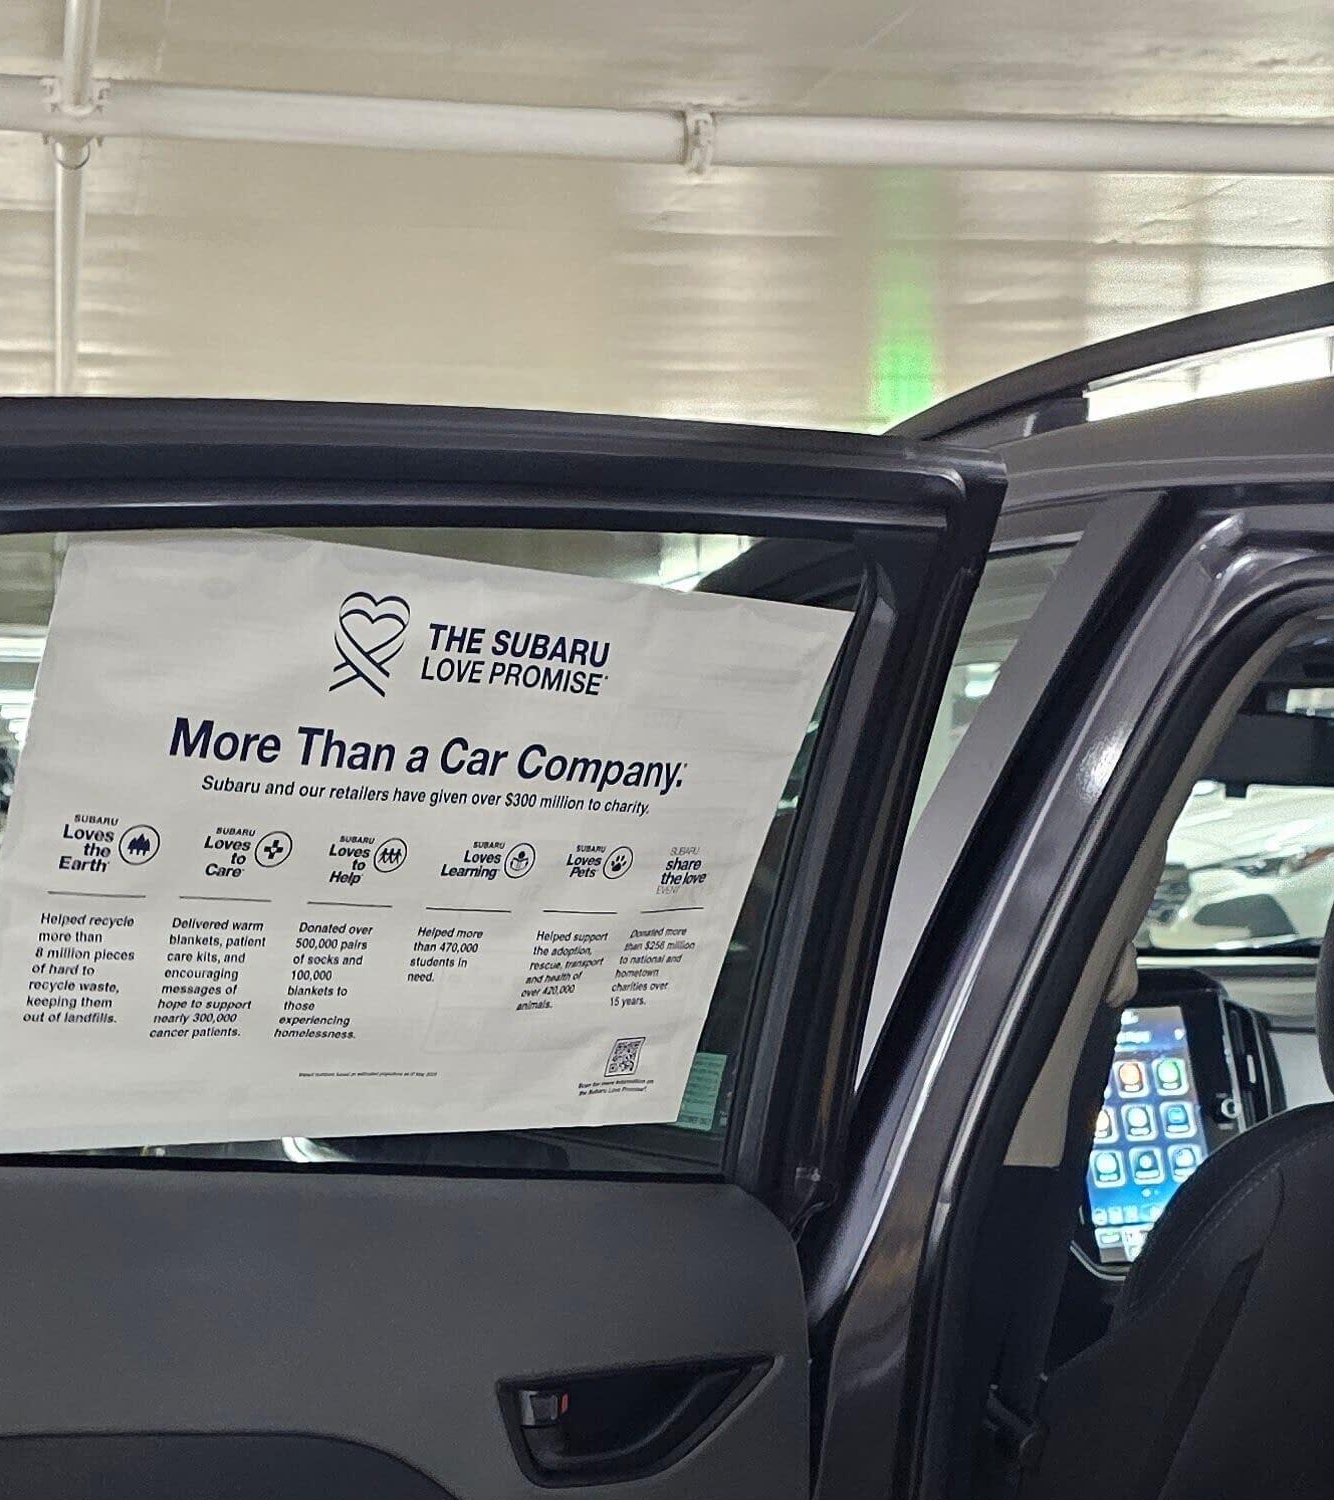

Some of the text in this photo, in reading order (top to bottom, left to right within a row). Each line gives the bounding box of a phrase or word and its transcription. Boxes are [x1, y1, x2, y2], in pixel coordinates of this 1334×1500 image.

[429, 622, 611, 669] THE SUBARU
[420, 655, 603, 696] LOVE PROMISE
[169, 716, 686, 796] More Than a Car Company.
[201, 774, 650, 818] Subaru and our retailers have given over $300 million to charity.
[74, 814, 119, 827] SUBARU
[62, 823, 115, 843] Loves
[215, 827, 256, 837] SUBARU
[203, 835, 252, 852] Loves
[339, 835, 376, 845] SUBARU
[472, 841, 506, 850] SUBARU
[83, 842, 111, 858] the
[328, 843, 371, 859] Loves
[576, 844, 607, 854] SUBARU
[670, 846, 700, 856] SUBARU
[58, 855, 107, 873] Earth
[230, 852, 247, 866] to
[463, 849, 502, 865] Loves
[566, 853, 603, 867] Loves
[665, 856, 702, 871] share
[205, 862, 242, 878] Care
[352, 858, 367, 871] to
[328, 870, 362, 887] Help
[440, 863, 500, 881] Learning
[569, 866, 597, 878] Pets
[660, 871, 707, 886] the love
[40, 912, 135, 929] Helped recycle
[171, 917, 264, 932] Delivered warm
[298, 921, 374, 935] Donated over
[417, 926, 484, 940] Helped more
[629, 926, 688, 939] Donated more
[38, 930, 103, 943] more than
[169, 933, 266, 950] blankets, patient
[536, 930, 609, 944] Helped support
[295, 937, 368, 952] 500,000 pairs
[413, 940, 479, 954] than 470,000
[532, 945, 593, 958] the adoption,
[623, 942, 643, 952] than
[665, 940, 696, 951] million
[35, 946, 135, 963] 8 million pieces
[167, 950, 246, 965] care kits, and
[292, 953, 364, 966] of socks and
[619, 953, 684, 965] to national and
[409, 956, 468, 968] students in
[529, 957, 605, 971] rescue, transport
[31, 963, 95, 976] of hard to
[164, 967, 239, 982] encouraging
[291, 969, 333, 982] 100,000
[614, 968, 660, 979] hometown
[407, 971, 435, 983] need.
[525, 970, 584, 985] and health of
[28, 979, 120, 994] recycle waste,
[161, 983, 238, 998] messages of
[287, 985, 348, 997] blankets to
[520, 983, 576, 998] over 420,000
[611, 981, 669, 993] charities over
[26, 995, 113, 1010] keeping them
[157, 998, 252, 1012] hope to support
[283, 1000, 315, 1011] those
[515, 999, 553, 1011] animals.
[610, 996, 647, 1009] 15 years.
[23, 1011, 117, 1024] out of landfills.
[153, 1012, 238, 1026] nearly 300,000
[278, 1015, 351, 1029] experiencing
[149, 1026, 241, 1040] cancer patients.
[273, 1028, 356, 1040] homelessness.
